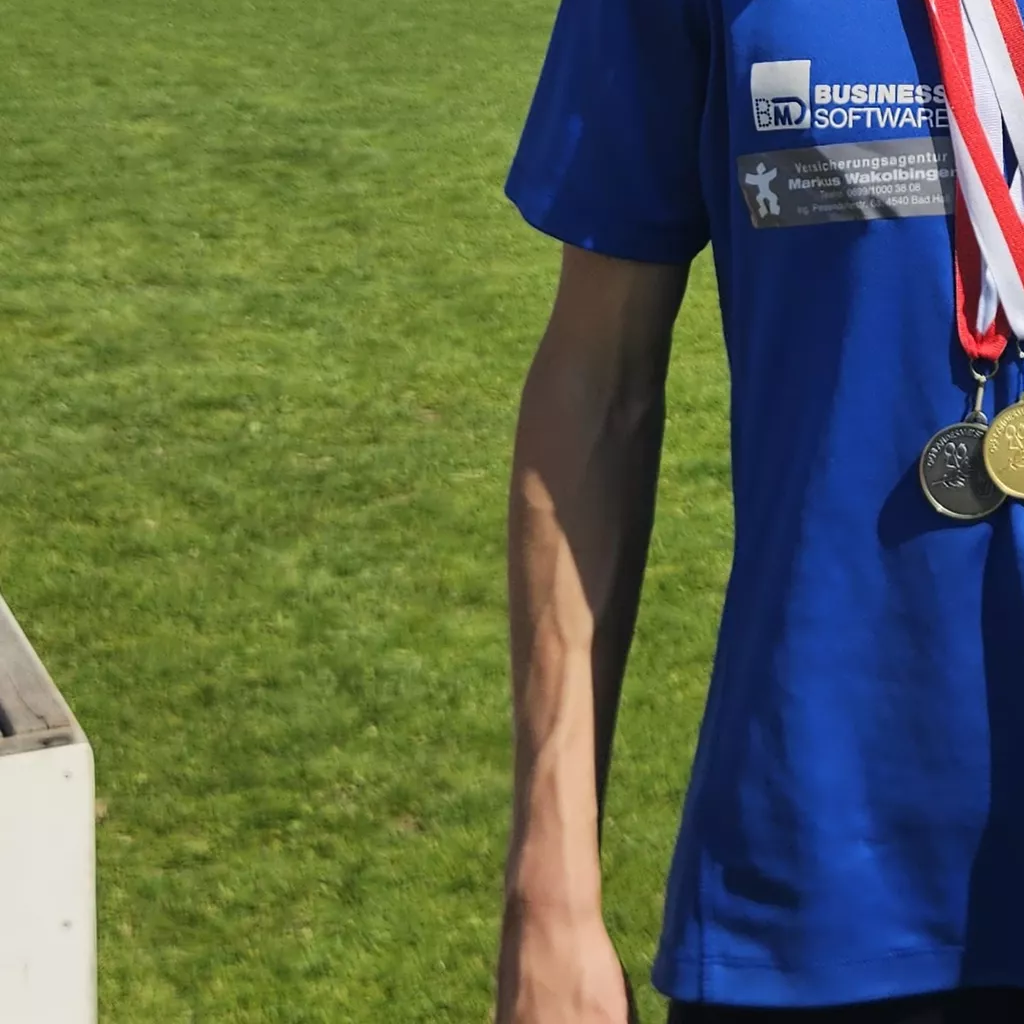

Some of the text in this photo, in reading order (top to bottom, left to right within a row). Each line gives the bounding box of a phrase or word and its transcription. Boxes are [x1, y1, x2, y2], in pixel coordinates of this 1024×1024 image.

[814, 83, 947, 105] BUSINESS
[814, 106, 951, 129] SOFTWARE
[794, 151, 949, 174] Versicherungsagentur
[788, 176, 842, 191] Markus
